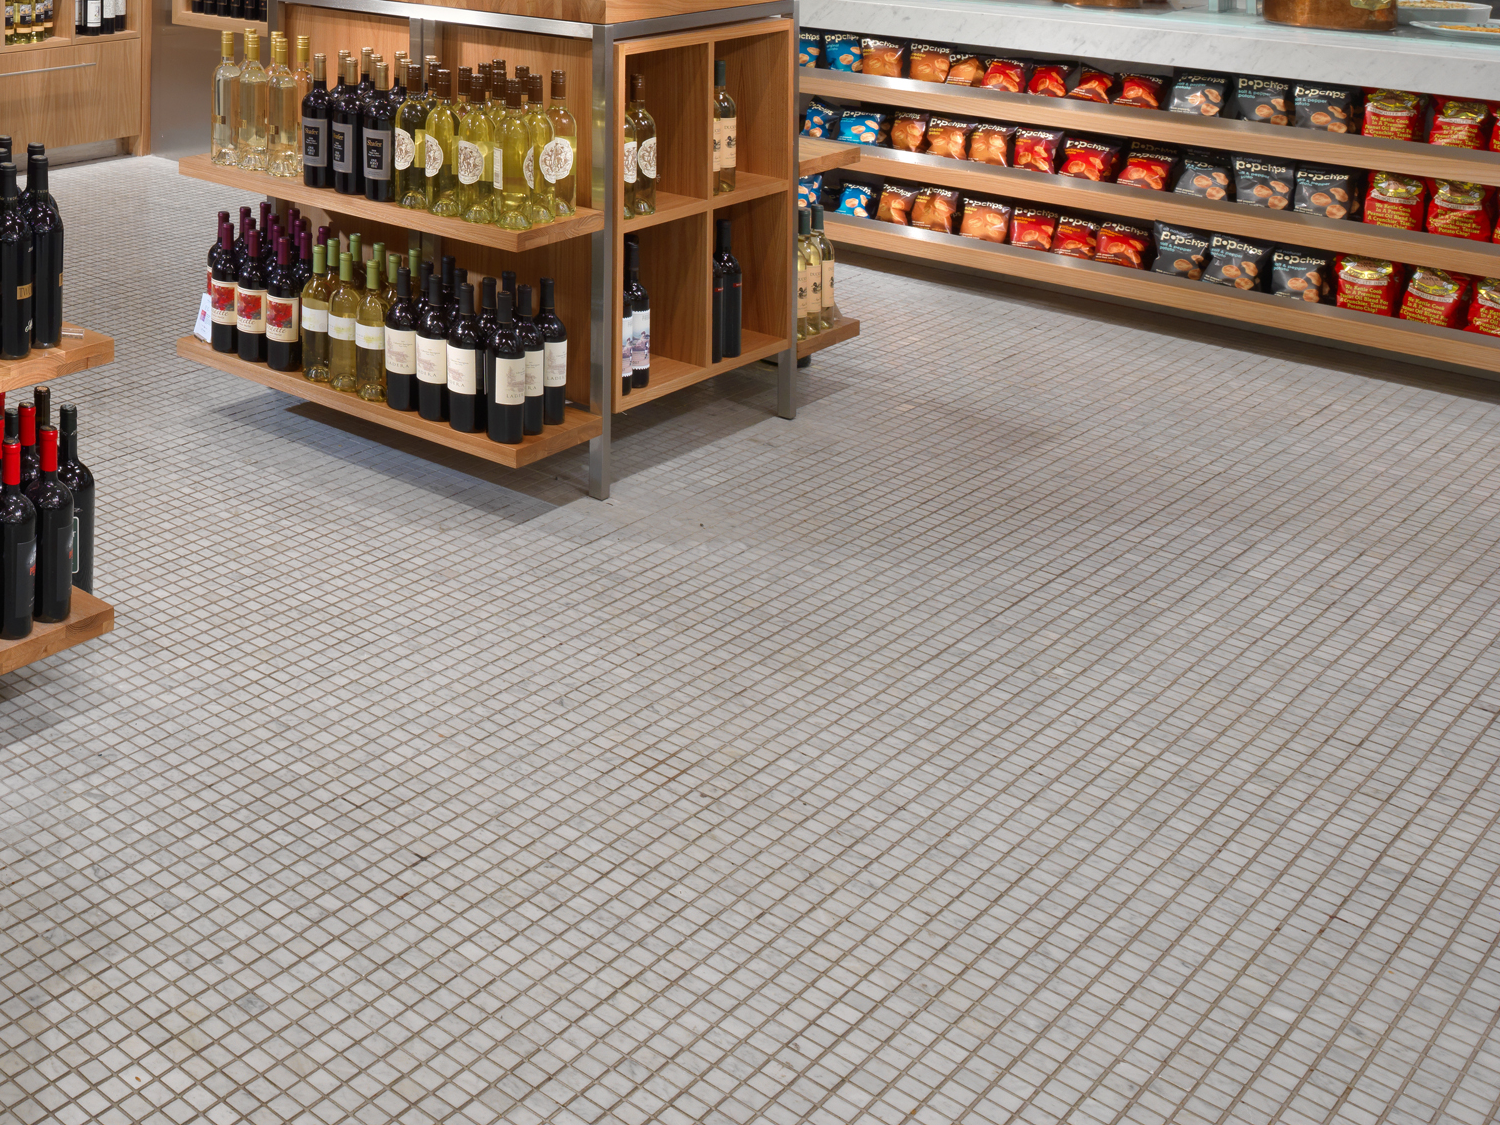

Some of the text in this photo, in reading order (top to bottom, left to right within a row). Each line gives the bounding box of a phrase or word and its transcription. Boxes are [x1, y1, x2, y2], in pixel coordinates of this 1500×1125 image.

[861, 38, 899, 49] popchips
[1238, 78, 1289, 91] popchips
[1295, 86, 1346, 99] popchips
[930, 118, 967, 128] popchips
[1066, 140, 1110, 152] popchips
[1235, 160, 1286, 174] popchips
[1297, 171, 1349, 181] popchips
[1015, 207, 1058, 219] popchips
[1102, 221, 1149, 236] popchips
[1212, 236, 1263, 256] popchips
[1274, 252, 1326, 265] popchips
